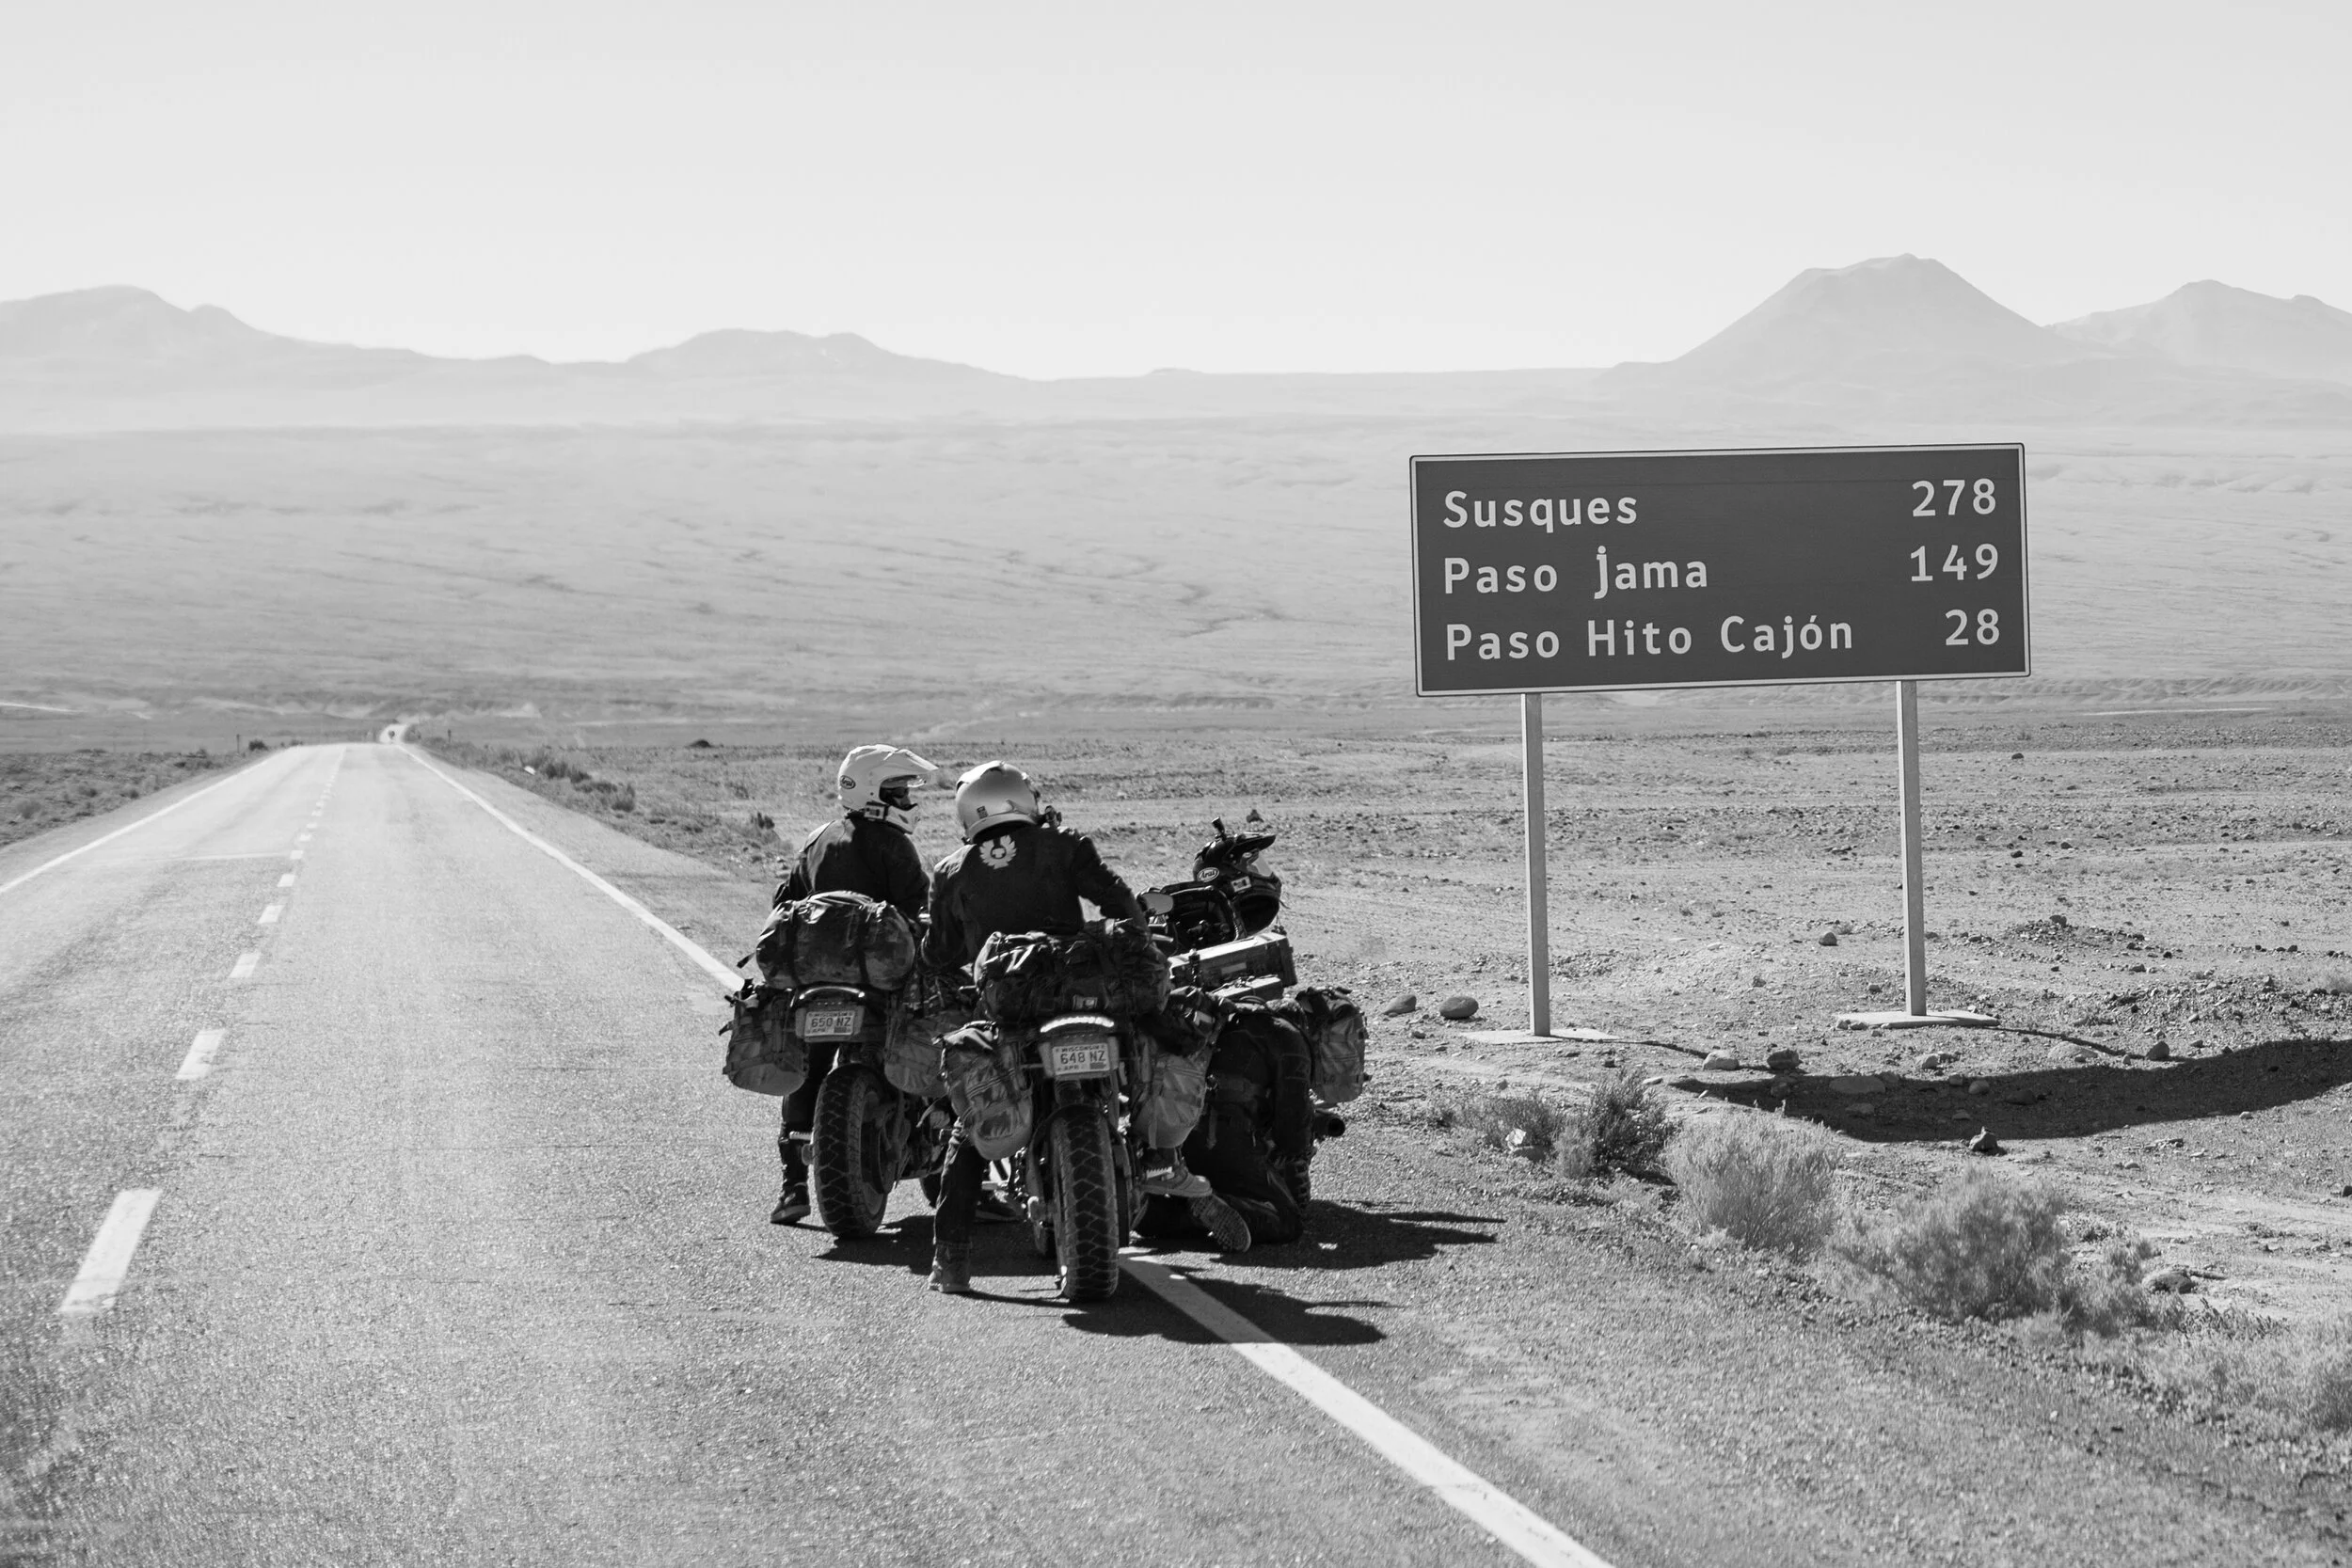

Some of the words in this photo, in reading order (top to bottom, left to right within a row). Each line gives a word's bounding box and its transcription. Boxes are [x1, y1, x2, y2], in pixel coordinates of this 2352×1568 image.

[1443, 489, 1638, 533] Susques
[1912, 478, 1996, 517] 278
[1444, 557, 1559, 594] Paso
[1594, 545, 1708, 600] jama
[1910, 543, 1998, 582] 149
[1446, 624, 1560, 661] Paso
[1587, 619, 1692, 657] Hito
[1720, 614, 1852, 659] Cajón
[1945, 608, 2000, 646] 28
[811, 1017, 834, 1028] 650
[835, 1017, 851, 1027] NZ
[1060, 1052, 1086, 1065] 648
[1089, 1050, 1107, 1062] NZ
